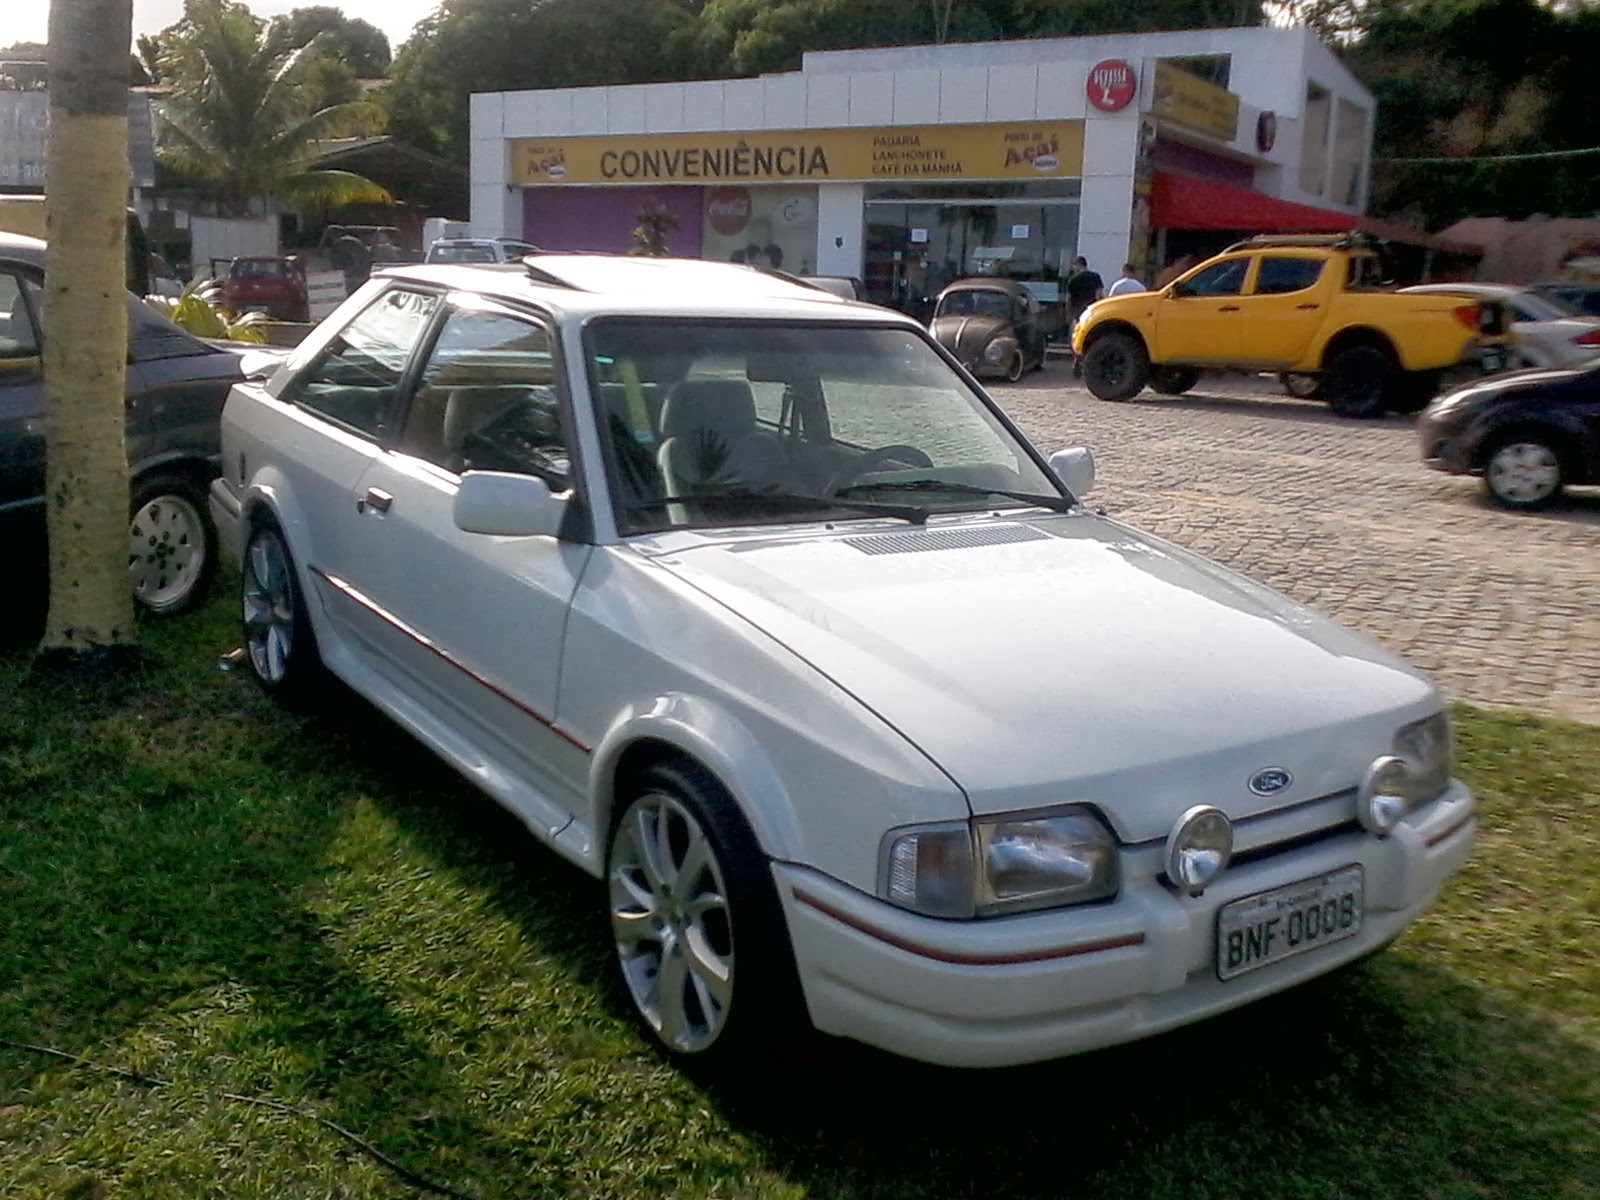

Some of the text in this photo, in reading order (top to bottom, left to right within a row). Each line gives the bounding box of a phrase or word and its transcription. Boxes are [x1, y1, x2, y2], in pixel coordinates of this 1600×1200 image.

[872, 135, 921, 147] PADARIA
[601, 140, 830, 178] CONVENIÊNCIA
[872, 148, 947, 161] LANCHONETE
[903, 164, 919, 174] DA
